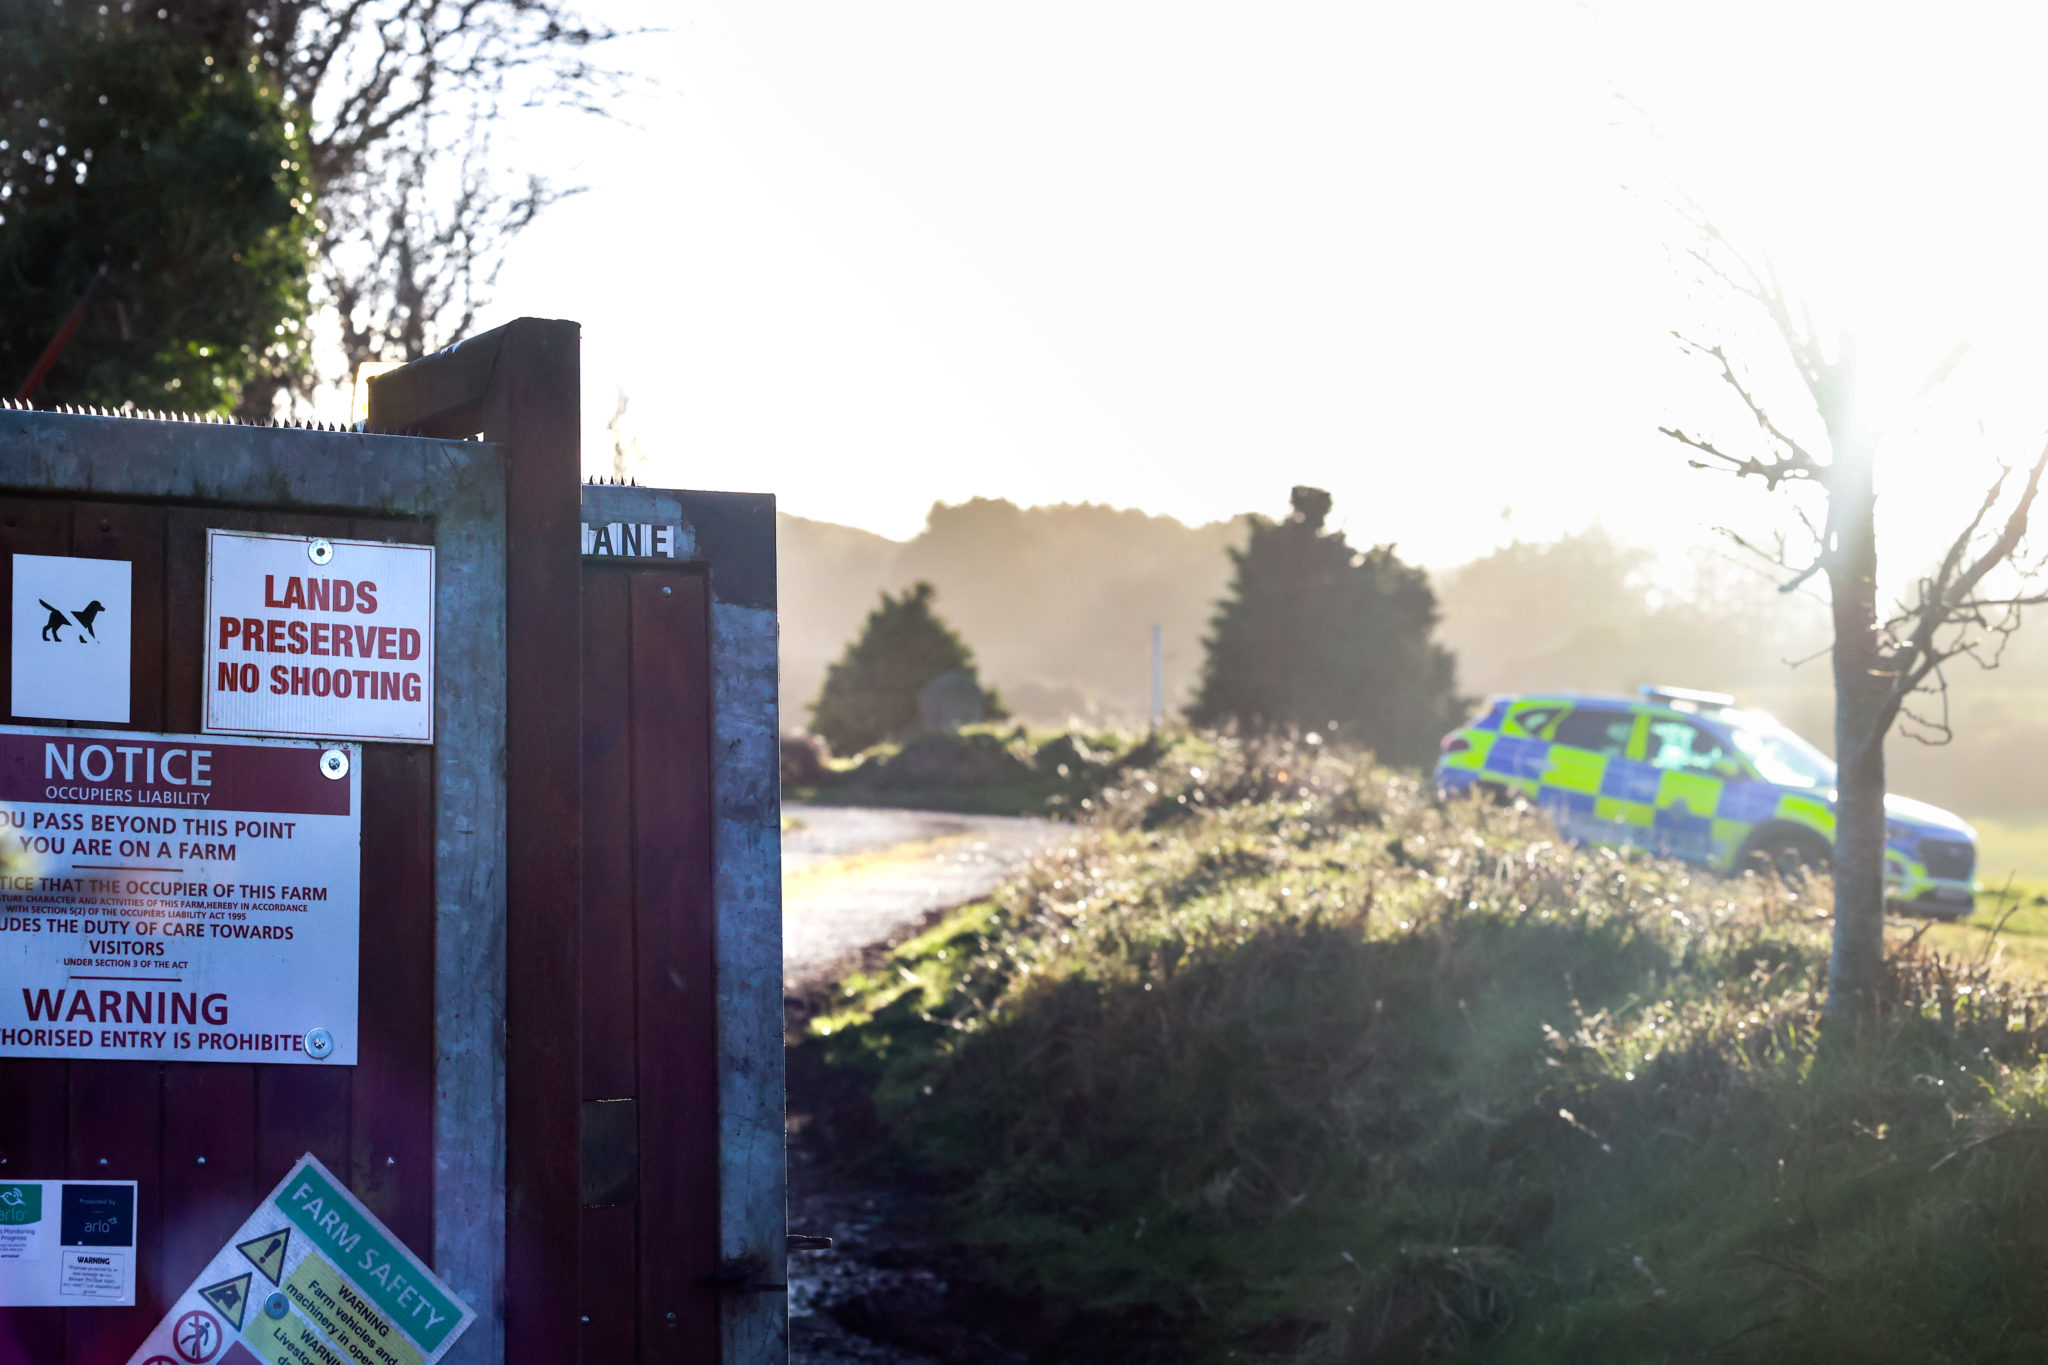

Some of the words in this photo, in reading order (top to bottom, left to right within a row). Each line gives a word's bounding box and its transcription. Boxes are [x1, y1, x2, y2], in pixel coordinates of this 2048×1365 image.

[589, 525, 668, 558] ANE
[264, 574, 378, 614] LANDS
[219, 617, 421, 660] PRESERVED
[218, 662, 260, 692] NO
[270, 665, 422, 702] SHOOTING
[45, 742, 213, 786] NOTICE
[45, 786, 133, 802] OCCUPIERS
[138, 790, 211, 805] LIABILITY
[0, 811, 25, 828] OU
[33, 812, 84, 831] PASS
[91, 815, 177, 834] BEYOND
[183, 818, 228, 836] THIS
[235, 820, 296, 839] POINT
[20, 836, 65, 855] YOU
[72, 838, 112, 856] ARE
[119, 840, 150, 857] ON
[157, 841, 172, 858] A
[179, 842, 236, 861] FARM
[0, 876, 34, 891] TICE
[39, 878, 84, 892] THAT
[89, 879, 120, 894] THE
[126, 880, 208, 896] OCCUPIER
[213, 883, 235, 898] OF
[239, 885, 276, 899] THIS
[281, 886, 328, 901] FARM
[0, 895, 23, 903] TURE
[26, 895, 76, 904] CHARACTER
[78, 897, 97, 905] AND
[100, 898, 144, 907] ACTIVITIES
[160, 900, 179, 908] THIS
[241, 902, 250, 910] IN
[251, 903, 308, 912] ACCORDANCE
[6, 905, 29, 913] WITH
[31, 906, 67, 915] SECTION
[70, 906, 86, 917] 5(2)
[88, 907, 100, 916] OF
[102, 908, 117, 916] THE
[120, 908, 166, 918] OCCUPIERS
[168, 910, 207, 919] LIABILITY
[209, 911, 225, 920] ACT
[228, 912, 247, 920] 1995
[0, 917, 41, 932] UDES
[46, 918, 78, 933] THE
[84, 920, 130, 935] DUTY
[135, 921, 158, 936] OF
[163, 922, 205, 937] CARE
[210, 924, 294, 940] TOWARDS
[89, 940, 165, 956] VISITORS
[64, 958, 93, 967] UNDER
[95, 959, 131, 967] SECTION
[133, 959, 138, 967] 3
[140, 960, 152, 968] OF
[154, 960, 170, 968] THE
[172, 961, 189, 969] ACT
[22, 988, 228, 1026] WARNING
[0, 1028, 93, 1047] HORISED
[101, 1030, 167, 1049] ENTRY
[174, 1032, 191, 1049] IS
[198, 1032, 303, 1051] PROHIBITE
[84, 1218, 110, 1233] arlo
[77, 1256, 110, 1265] WARNING
[292, 1183, 361, 1253] FARM
[358, 1248, 446, 1330] SAFETY
[286, 1283, 339, 1335] machinery
[338, 1331, 350, 1346] in
[308, 1280, 335, 1309] Farm
[336, 1307, 376, 1348] vehicles
[375, 1345, 399, 1365] and
[338, 1284, 390, 1338] WARNING
